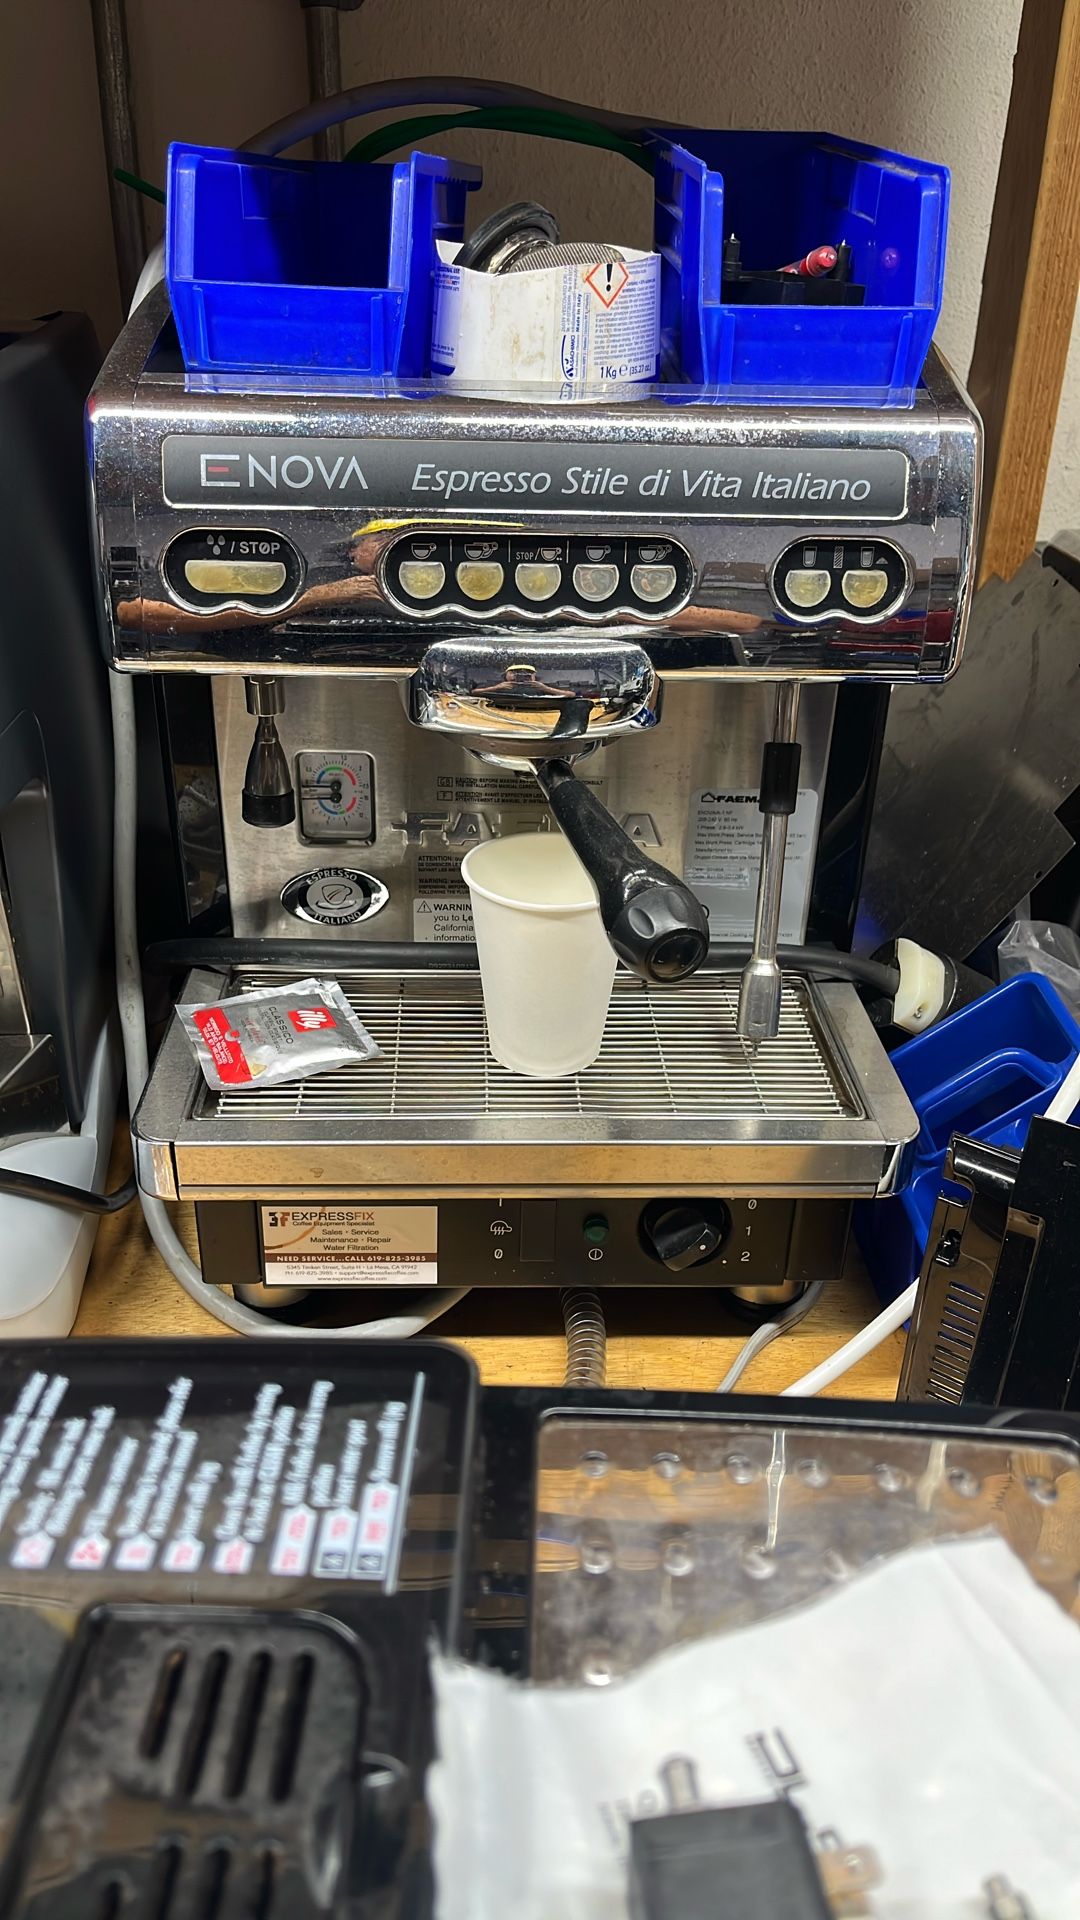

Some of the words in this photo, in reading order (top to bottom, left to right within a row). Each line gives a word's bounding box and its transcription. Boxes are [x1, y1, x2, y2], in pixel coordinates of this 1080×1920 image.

[200, 453, 369, 490] ENOVA
[412, 463, 552, 499] Espresso
[561, 466, 629, 496] Stile
[638, 468, 672, 497] di
[682, 469, 742, 498] Vita
[752, 471, 871, 501] Italiano
[716, 795, 760, 803] FAEM
[305, 869, 358, 885] ESPRESSO
[433, 903, 473, 911] WARNIN
[313, 911, 362, 924] ITALIANO
[433, 915, 449, 923] you
[452, 914, 460, 922] to
[462, 914, 474, 922] Le
[433, 923, 474, 932] California
[433, 934, 477, 942] informatio
[295, 1009, 328, 1030] illy
[268, 1005, 295, 1045] CLASSICO
[291, 1211, 375, 1221] EXPRESSFIX
